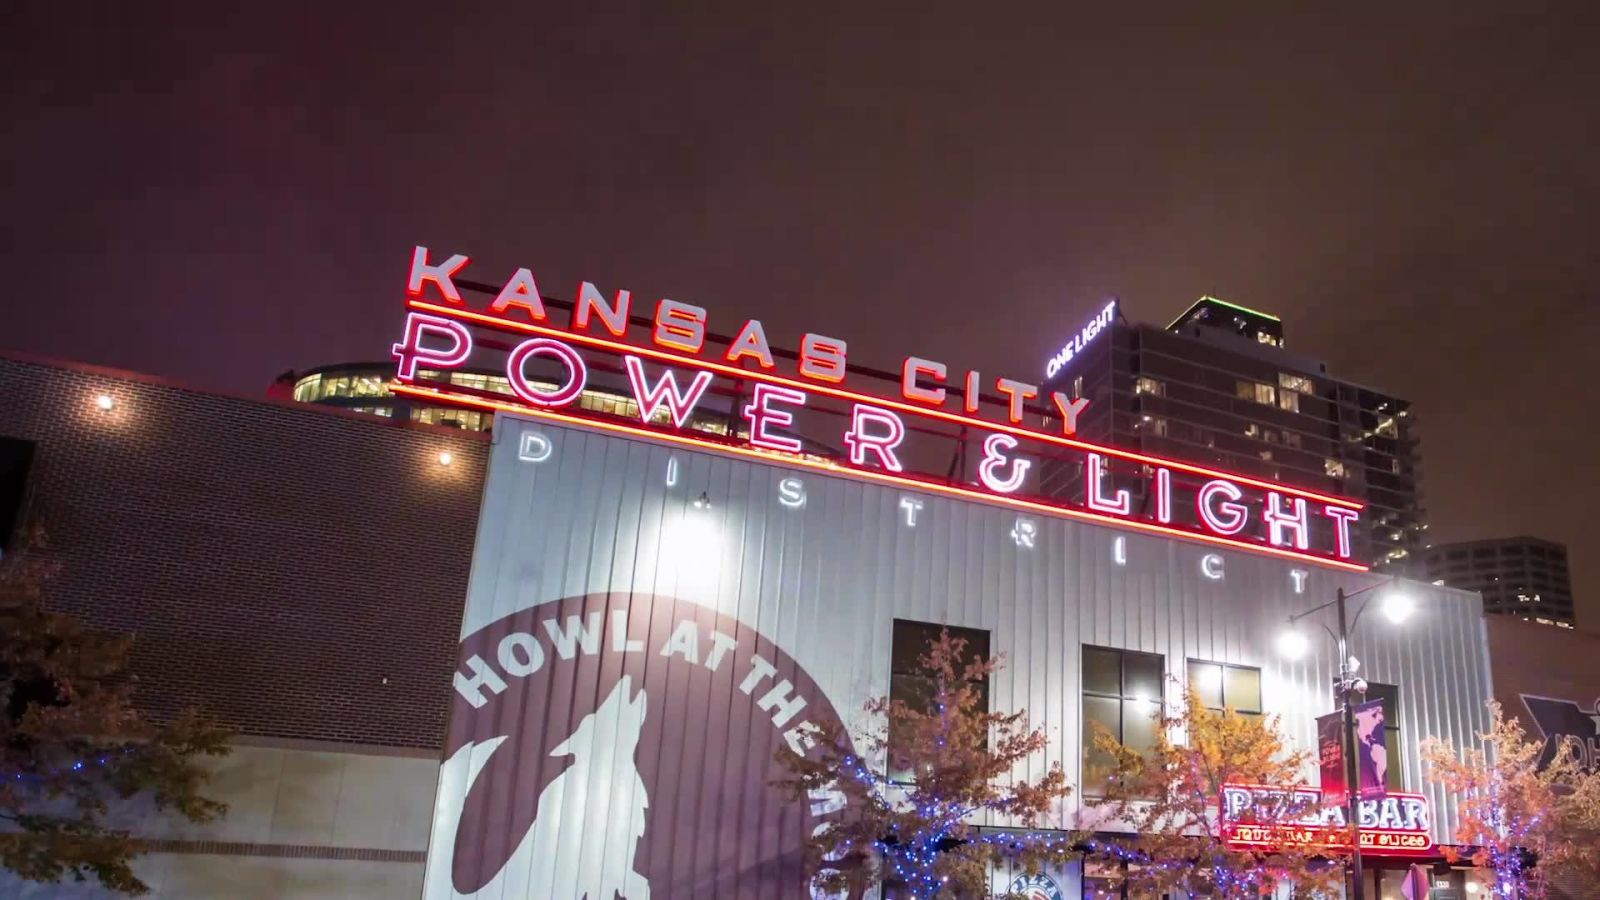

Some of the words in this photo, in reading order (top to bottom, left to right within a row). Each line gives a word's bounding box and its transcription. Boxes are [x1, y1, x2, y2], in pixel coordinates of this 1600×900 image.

[408, 246, 847, 383] KANSAS
[902, 357, 1089, 434] CITY
[1046, 341, 1074, 378] ONE
[1075, 301, 1115, 353] LIGHT
[393, 312, 905, 472] POWER
[978, 433, 1031, 492] &
[1087, 453, 1359, 559] LIGHT
[519, 432, 1308, 593] DISTRICT
[453, 609, 643, 709] HOWL
[660, 620, 738, 672] AT
[738, 654, 821, 757] THE
[1357, 797, 1428, 830] BAR
